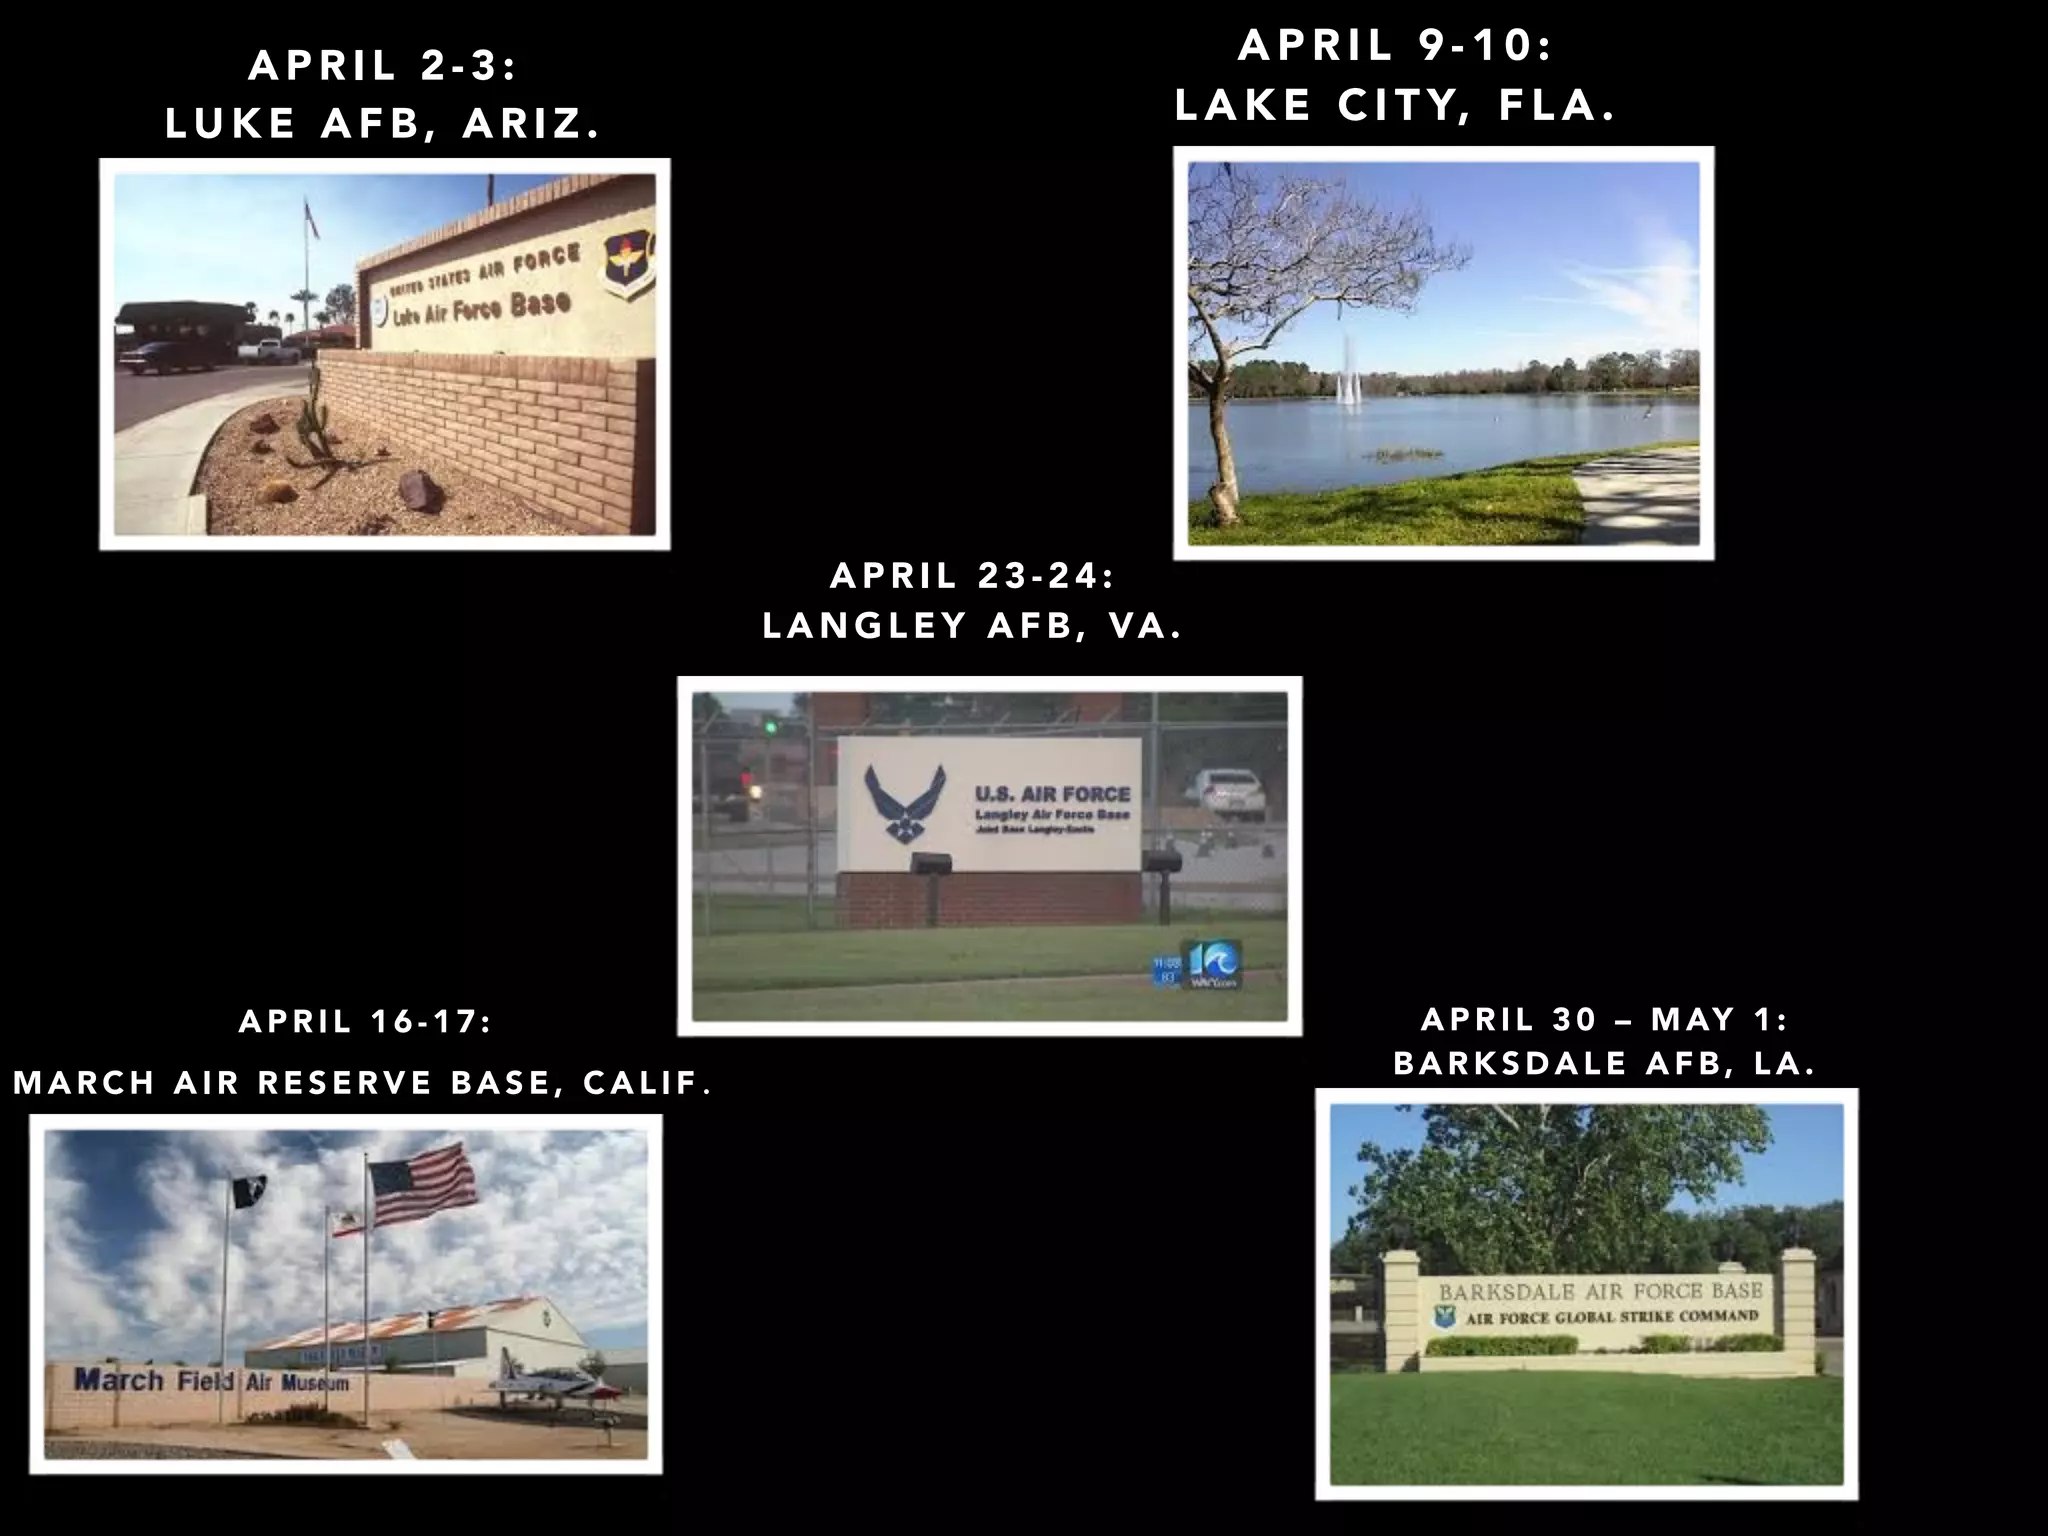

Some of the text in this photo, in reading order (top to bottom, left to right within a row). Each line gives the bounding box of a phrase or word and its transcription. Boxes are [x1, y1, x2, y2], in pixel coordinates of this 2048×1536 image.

[428, 269, 470, 289] STATES
[479, 261, 505, 280] AIR
[513, 242, 581, 274] FORCE
[425, 303, 448, 324] Air
[453, 299, 501, 322] Force
[510, 291, 572, 317] Base
[975, 786, 1131, 802] U.S. AIR FORCE
[975, 809, 1130, 823] Langley Air Force Base
[1439, 1282, 1764, 1301] BARKSDALE AIR FORCE BASE
[1466, 1309, 1759, 1326] AIR FORCE GLOBAL STRIKE COMMAND
[73, 1366, 349, 1391] March Field Air Museum
